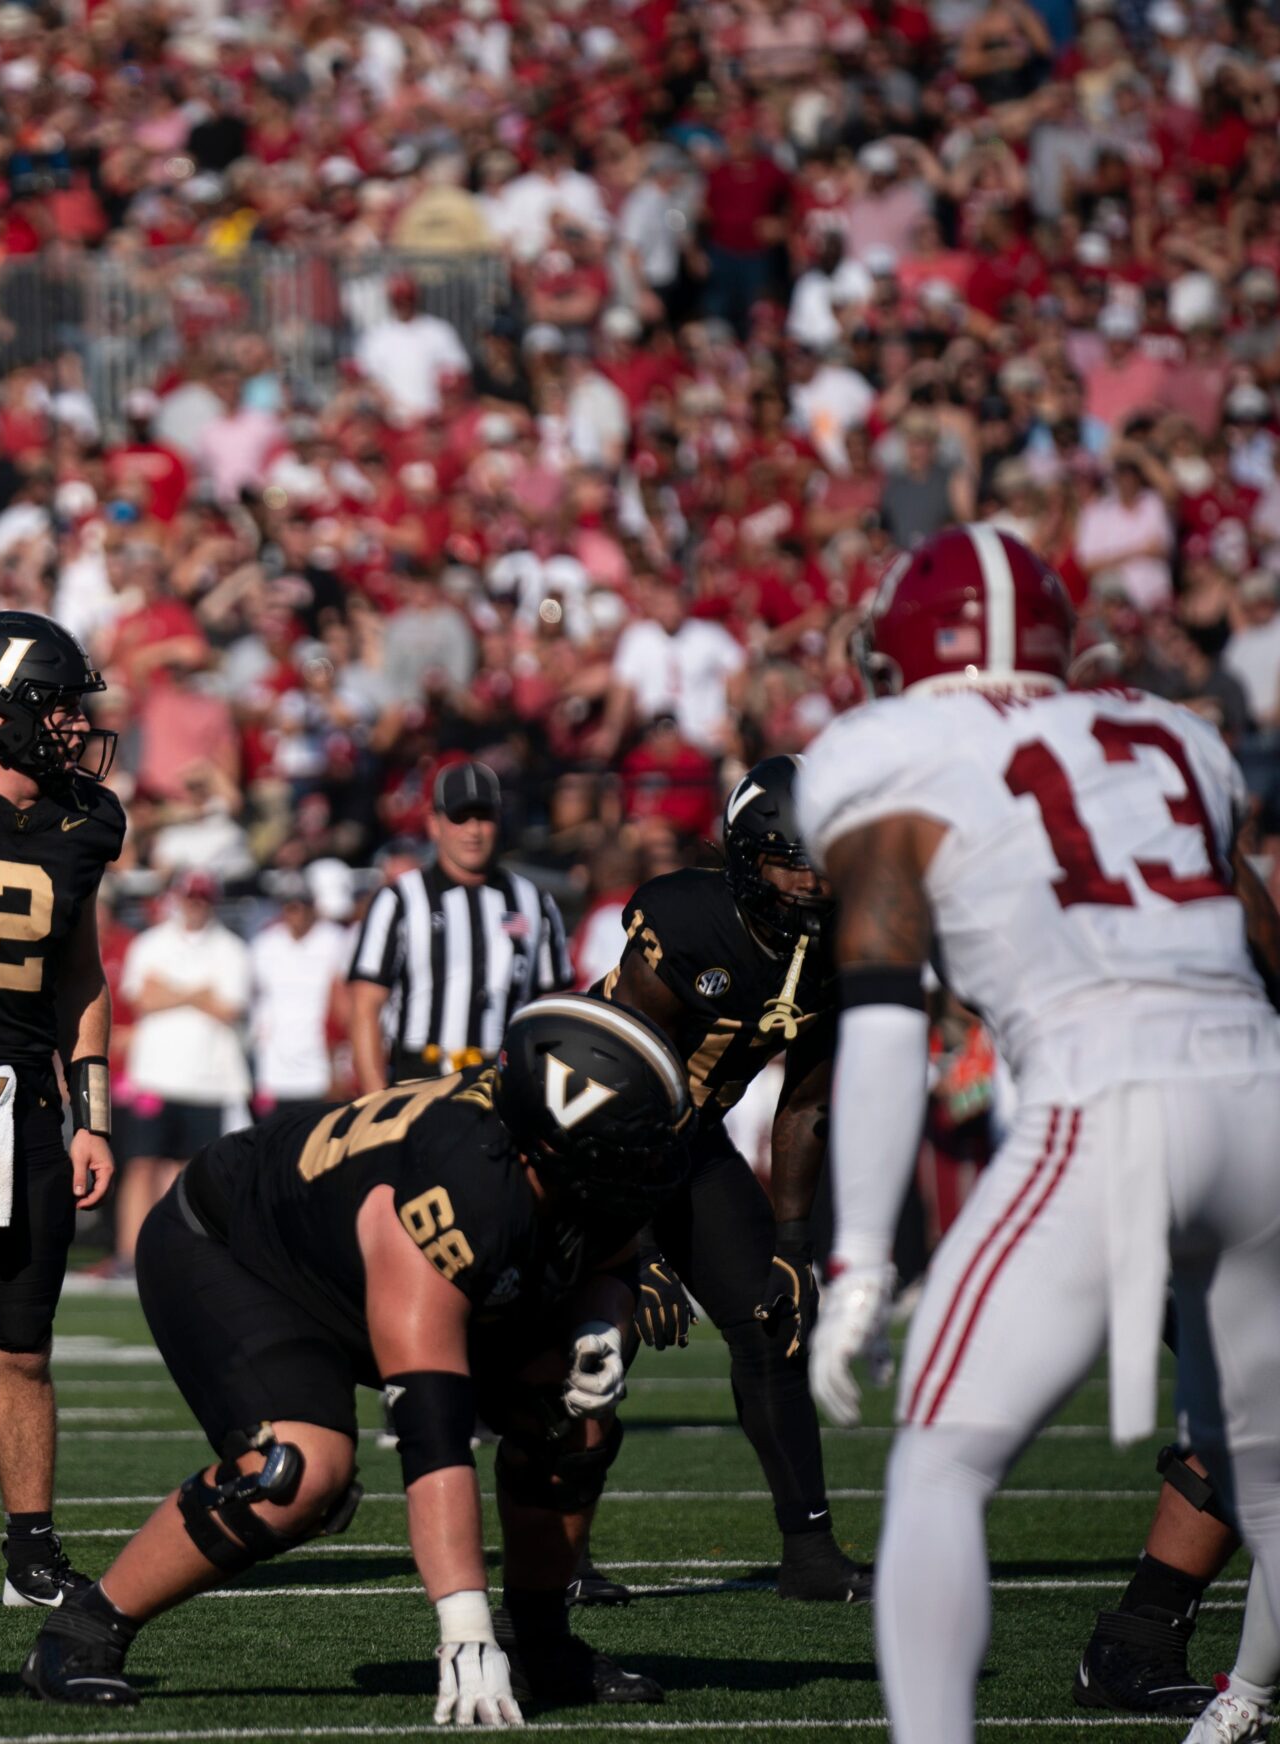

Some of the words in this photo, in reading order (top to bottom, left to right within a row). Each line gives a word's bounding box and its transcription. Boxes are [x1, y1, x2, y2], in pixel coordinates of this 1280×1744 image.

[727, 776, 766, 825] V
[1003, 715, 1236, 910] 13
[697, 969, 729, 997] SEC
[545, 1052, 619, 1130] V
[400, 1185, 475, 1281] 68
